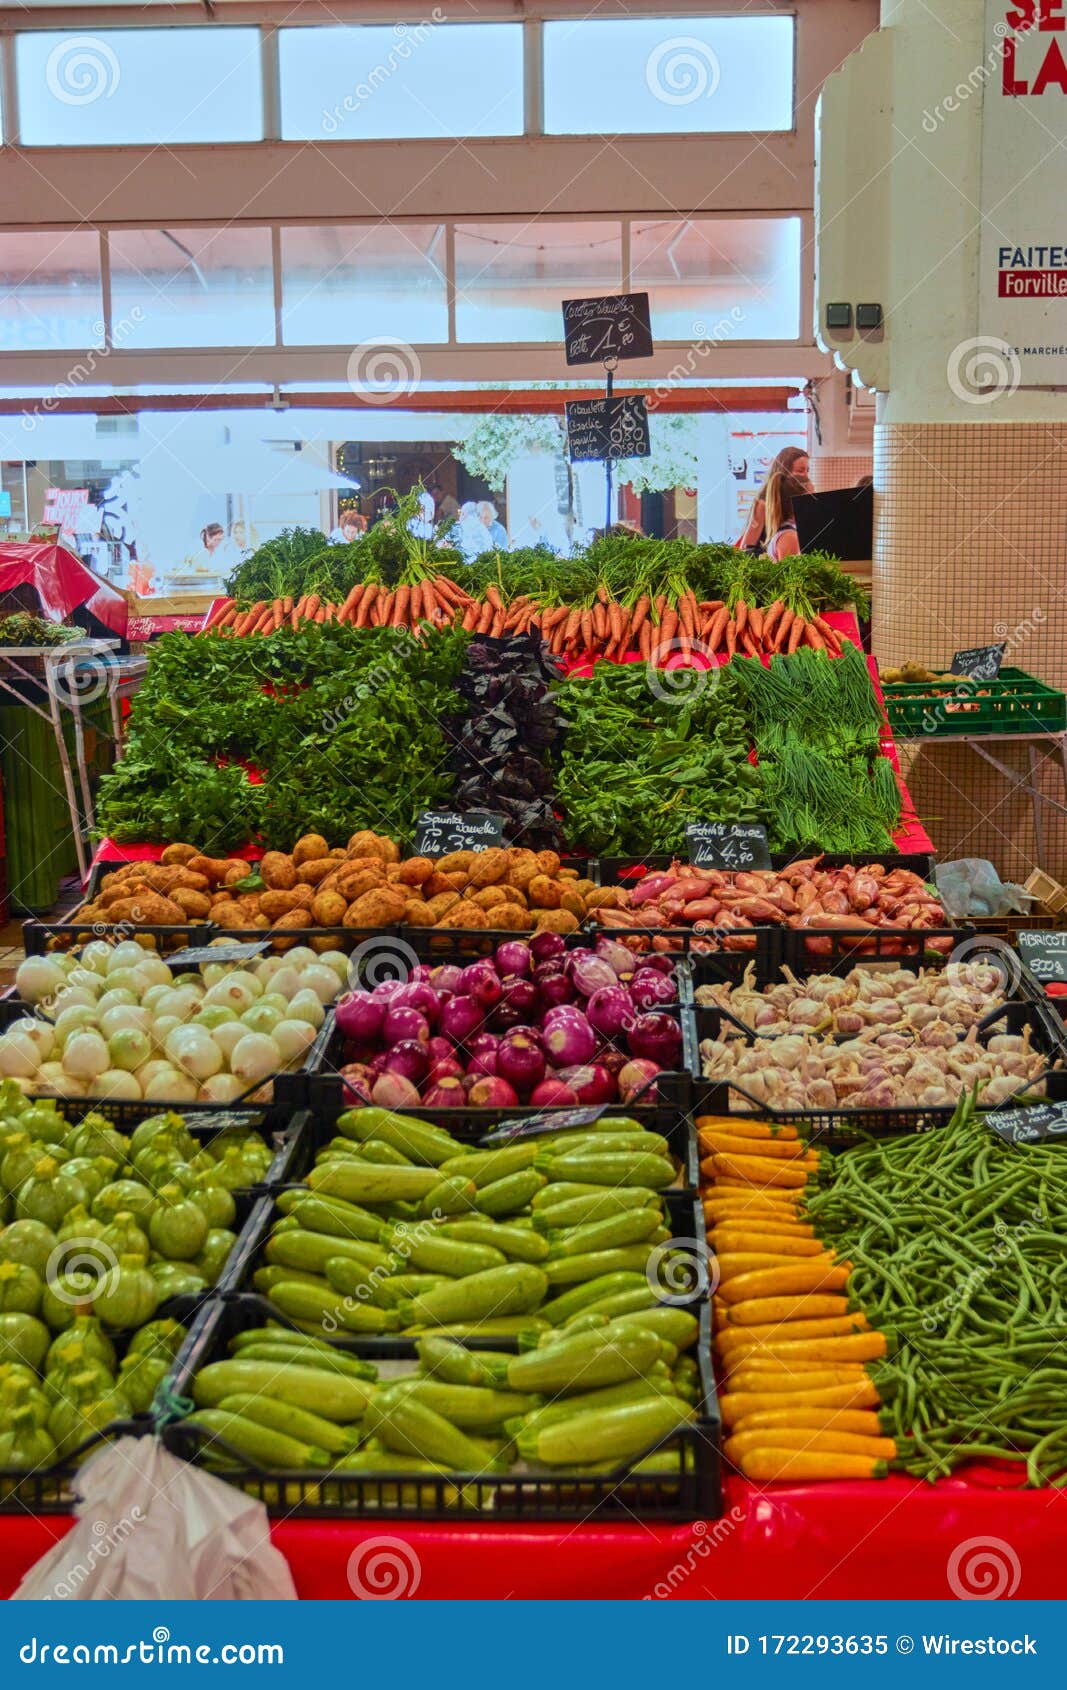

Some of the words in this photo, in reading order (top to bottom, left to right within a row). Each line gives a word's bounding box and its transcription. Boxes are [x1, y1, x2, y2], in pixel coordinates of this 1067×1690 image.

[1002, 35, 1067, 96] LA
[1005, 272, 1067, 295] Forville
[1001, 346, 1020, 356] LES
